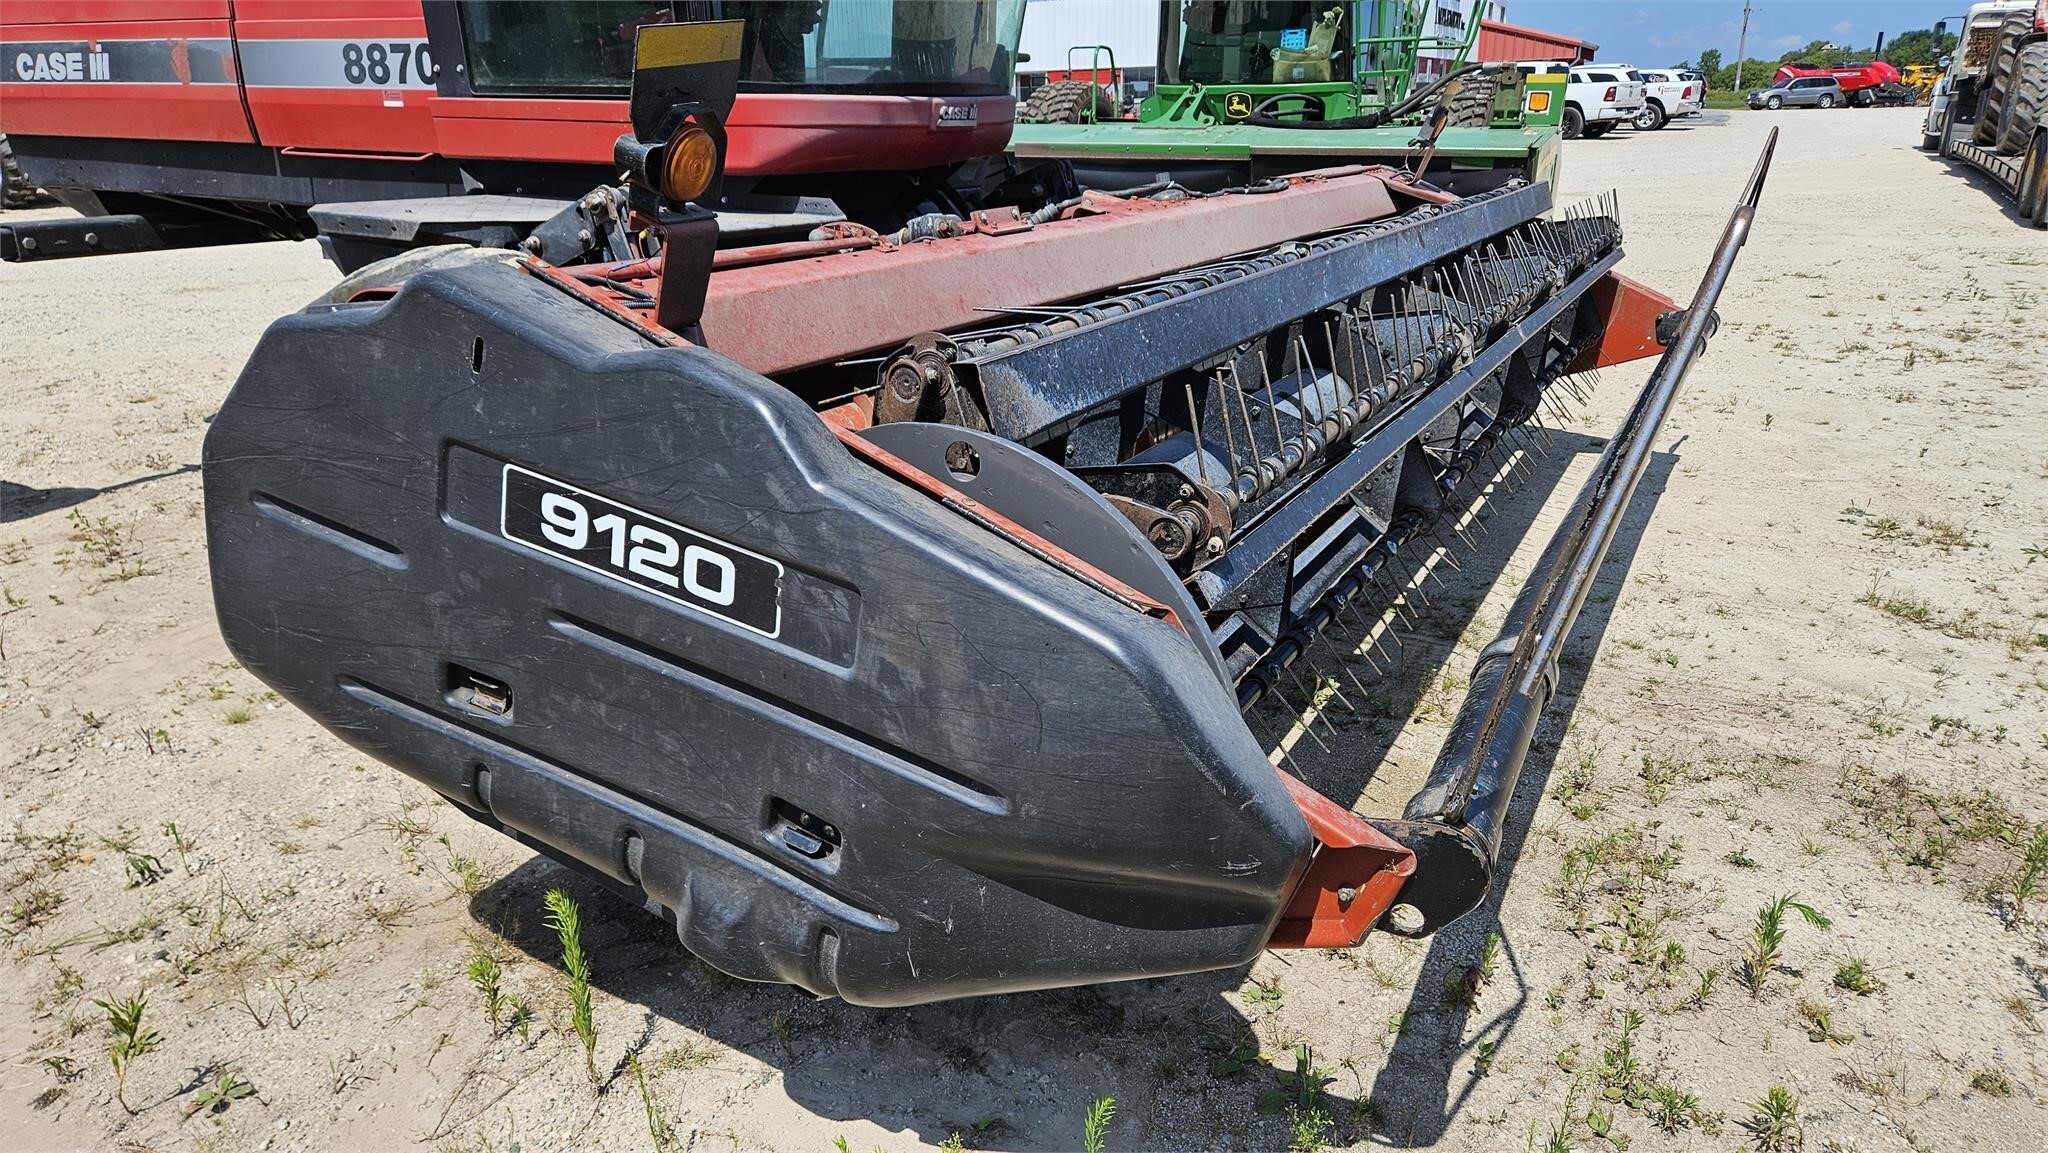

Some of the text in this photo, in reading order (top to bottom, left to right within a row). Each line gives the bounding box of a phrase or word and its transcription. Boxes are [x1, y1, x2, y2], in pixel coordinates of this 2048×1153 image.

[16, 52, 83, 80] CASE
[342, 43, 436, 85] 8870
[939, 105, 969, 120] CASE
[540, 492, 736, 606] 9120
